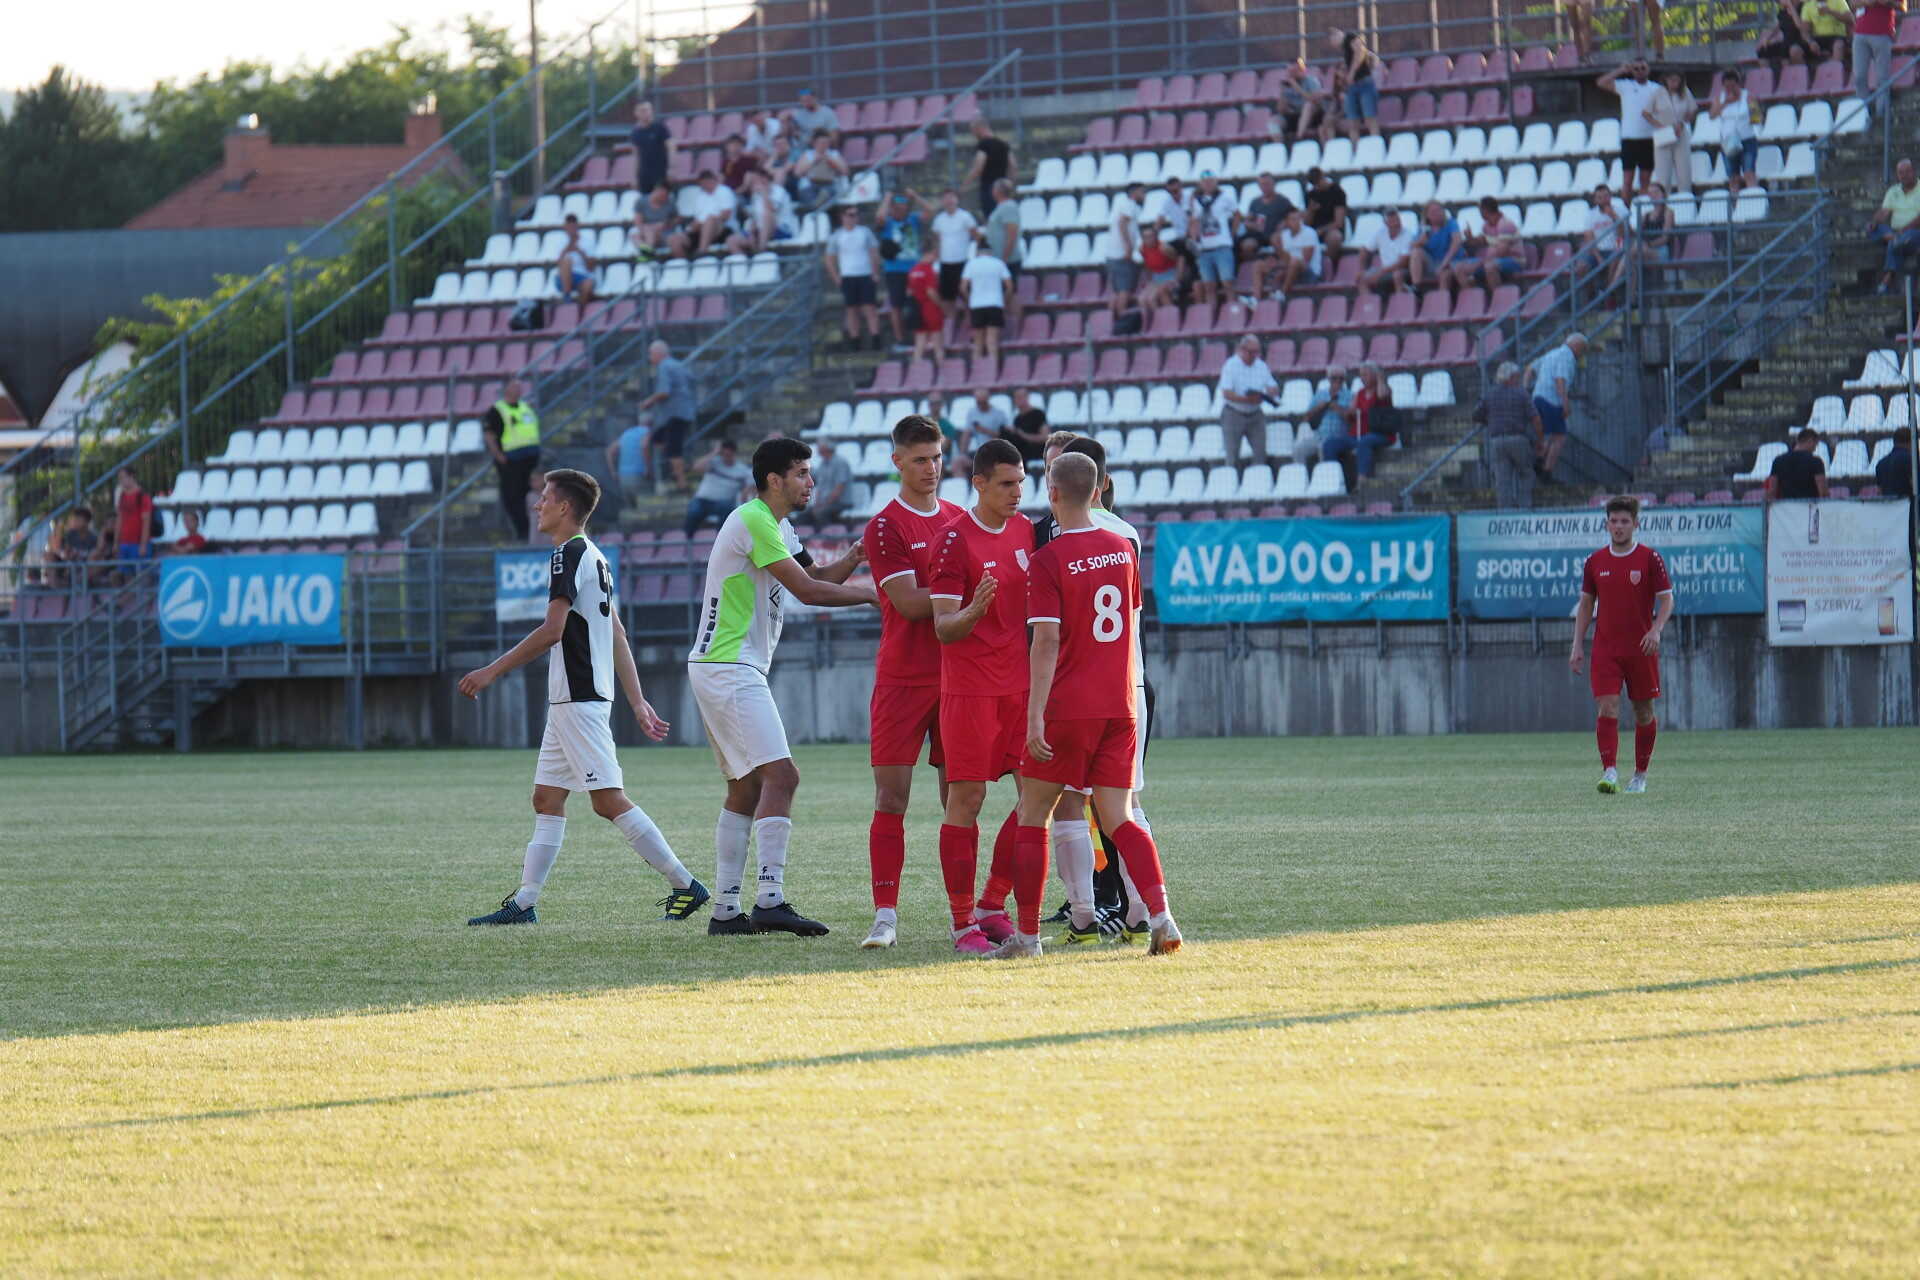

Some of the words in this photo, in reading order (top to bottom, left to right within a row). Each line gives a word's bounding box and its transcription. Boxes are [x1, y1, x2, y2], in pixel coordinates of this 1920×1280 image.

[1695, 513, 1733, 530] TOKA
[1068, 560, 1087, 575] SC
[1087, 551, 1133, 570] SOPRON
[1170, 541, 1435, 586] AVADOO.HU
[1476, 556, 1568, 579] SPORTOLJ
[1669, 546, 1746, 576] NÉLKÜL!
[219, 573, 334, 627] JAKO
[1474, 580, 1533, 599] LÉZERES
[1093, 584, 1123, 643] 8
[1814, 598, 1864, 613] SZERVIZ
